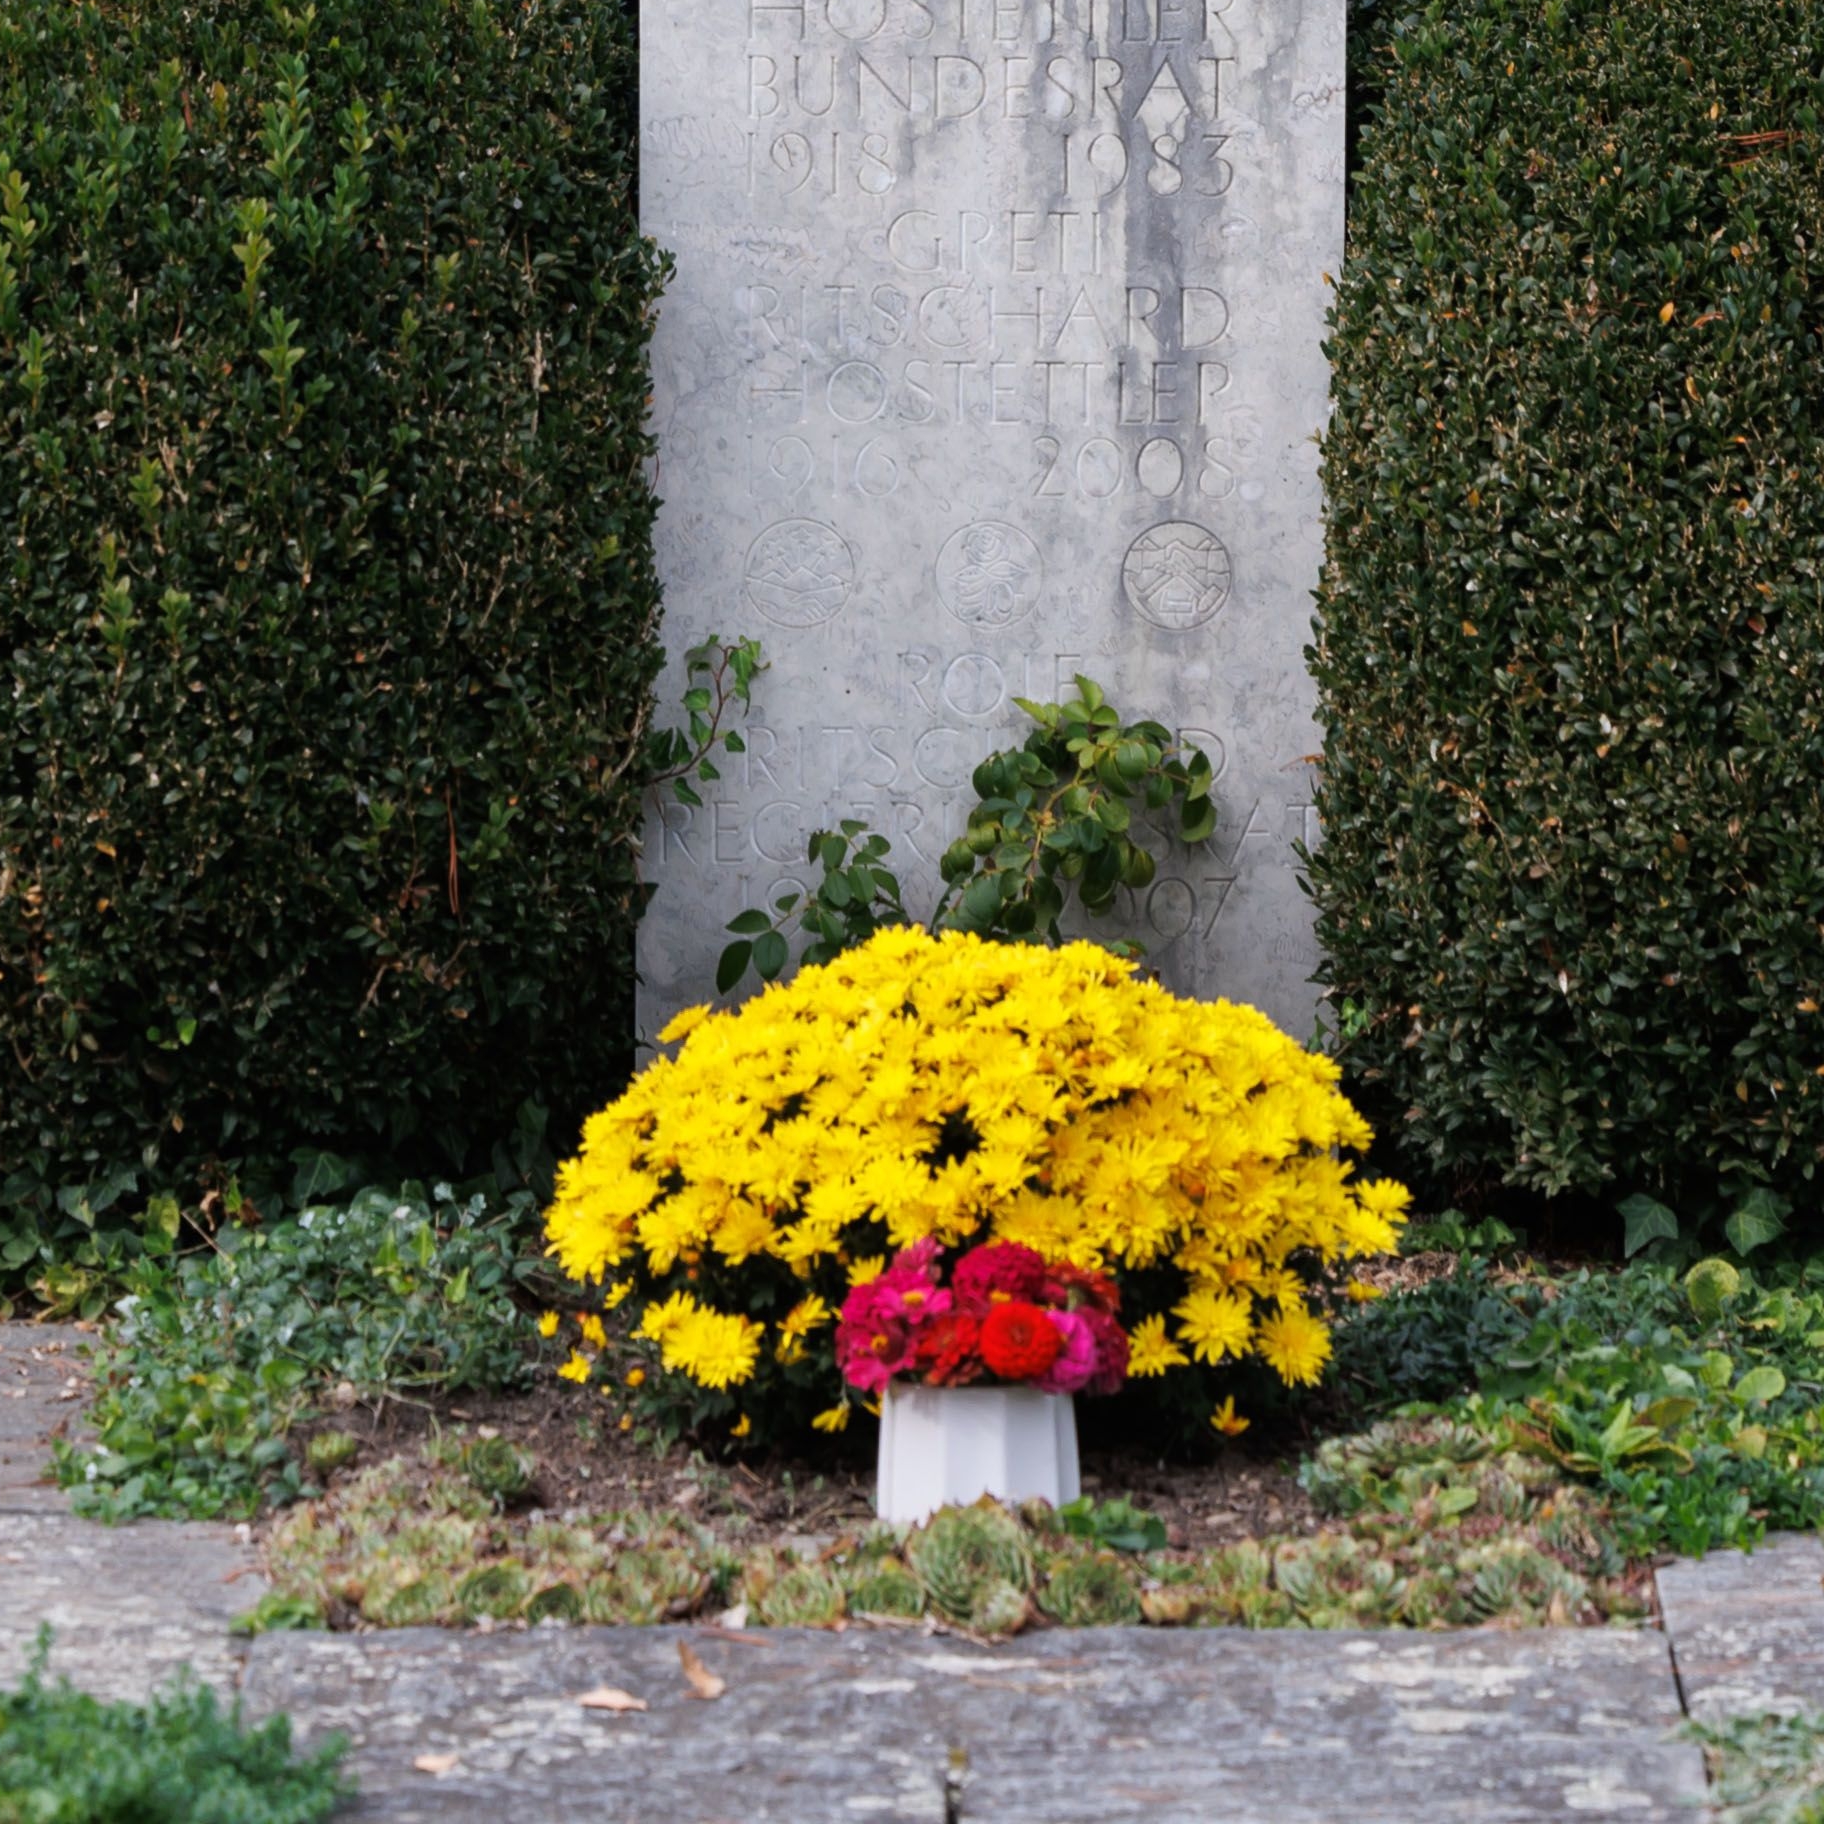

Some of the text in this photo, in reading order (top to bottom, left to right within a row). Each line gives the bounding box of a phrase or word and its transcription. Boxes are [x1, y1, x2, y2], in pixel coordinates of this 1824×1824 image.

[747, 55, 1238, 120] BUNDESRAT
[746, 132, 1235, 197] 1918 1983
[888, 210, 1101, 274] GRETI
[747, 286, 1231, 349] RITSCHARD
[746, 434, 1237, 499] 1916 2008
[744, 727, 1229, 791] RITSCD
